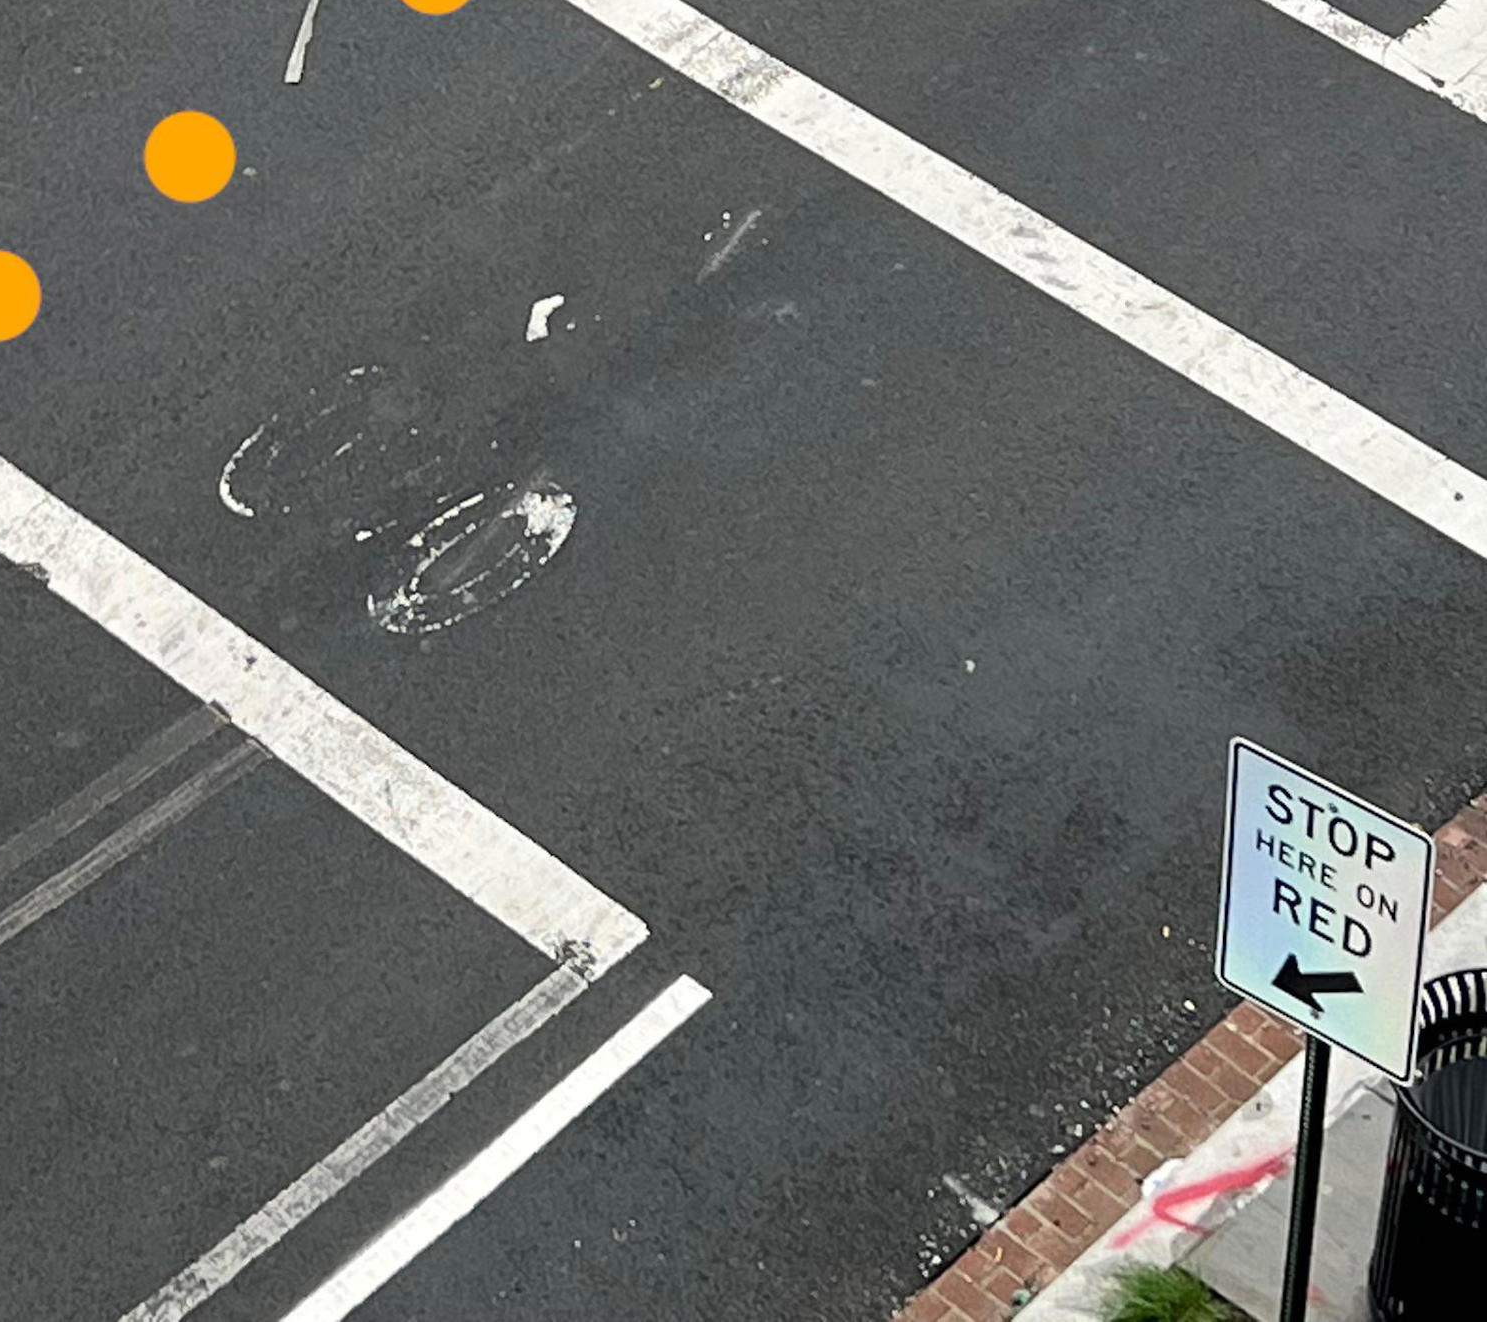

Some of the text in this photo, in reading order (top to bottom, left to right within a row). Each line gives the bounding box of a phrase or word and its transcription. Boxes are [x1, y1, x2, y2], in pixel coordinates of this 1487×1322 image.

[1265, 784, 1396, 869] STOP
[1256, 828, 1398, 923] HERE ON
[1272, 877, 1372, 957] RED
